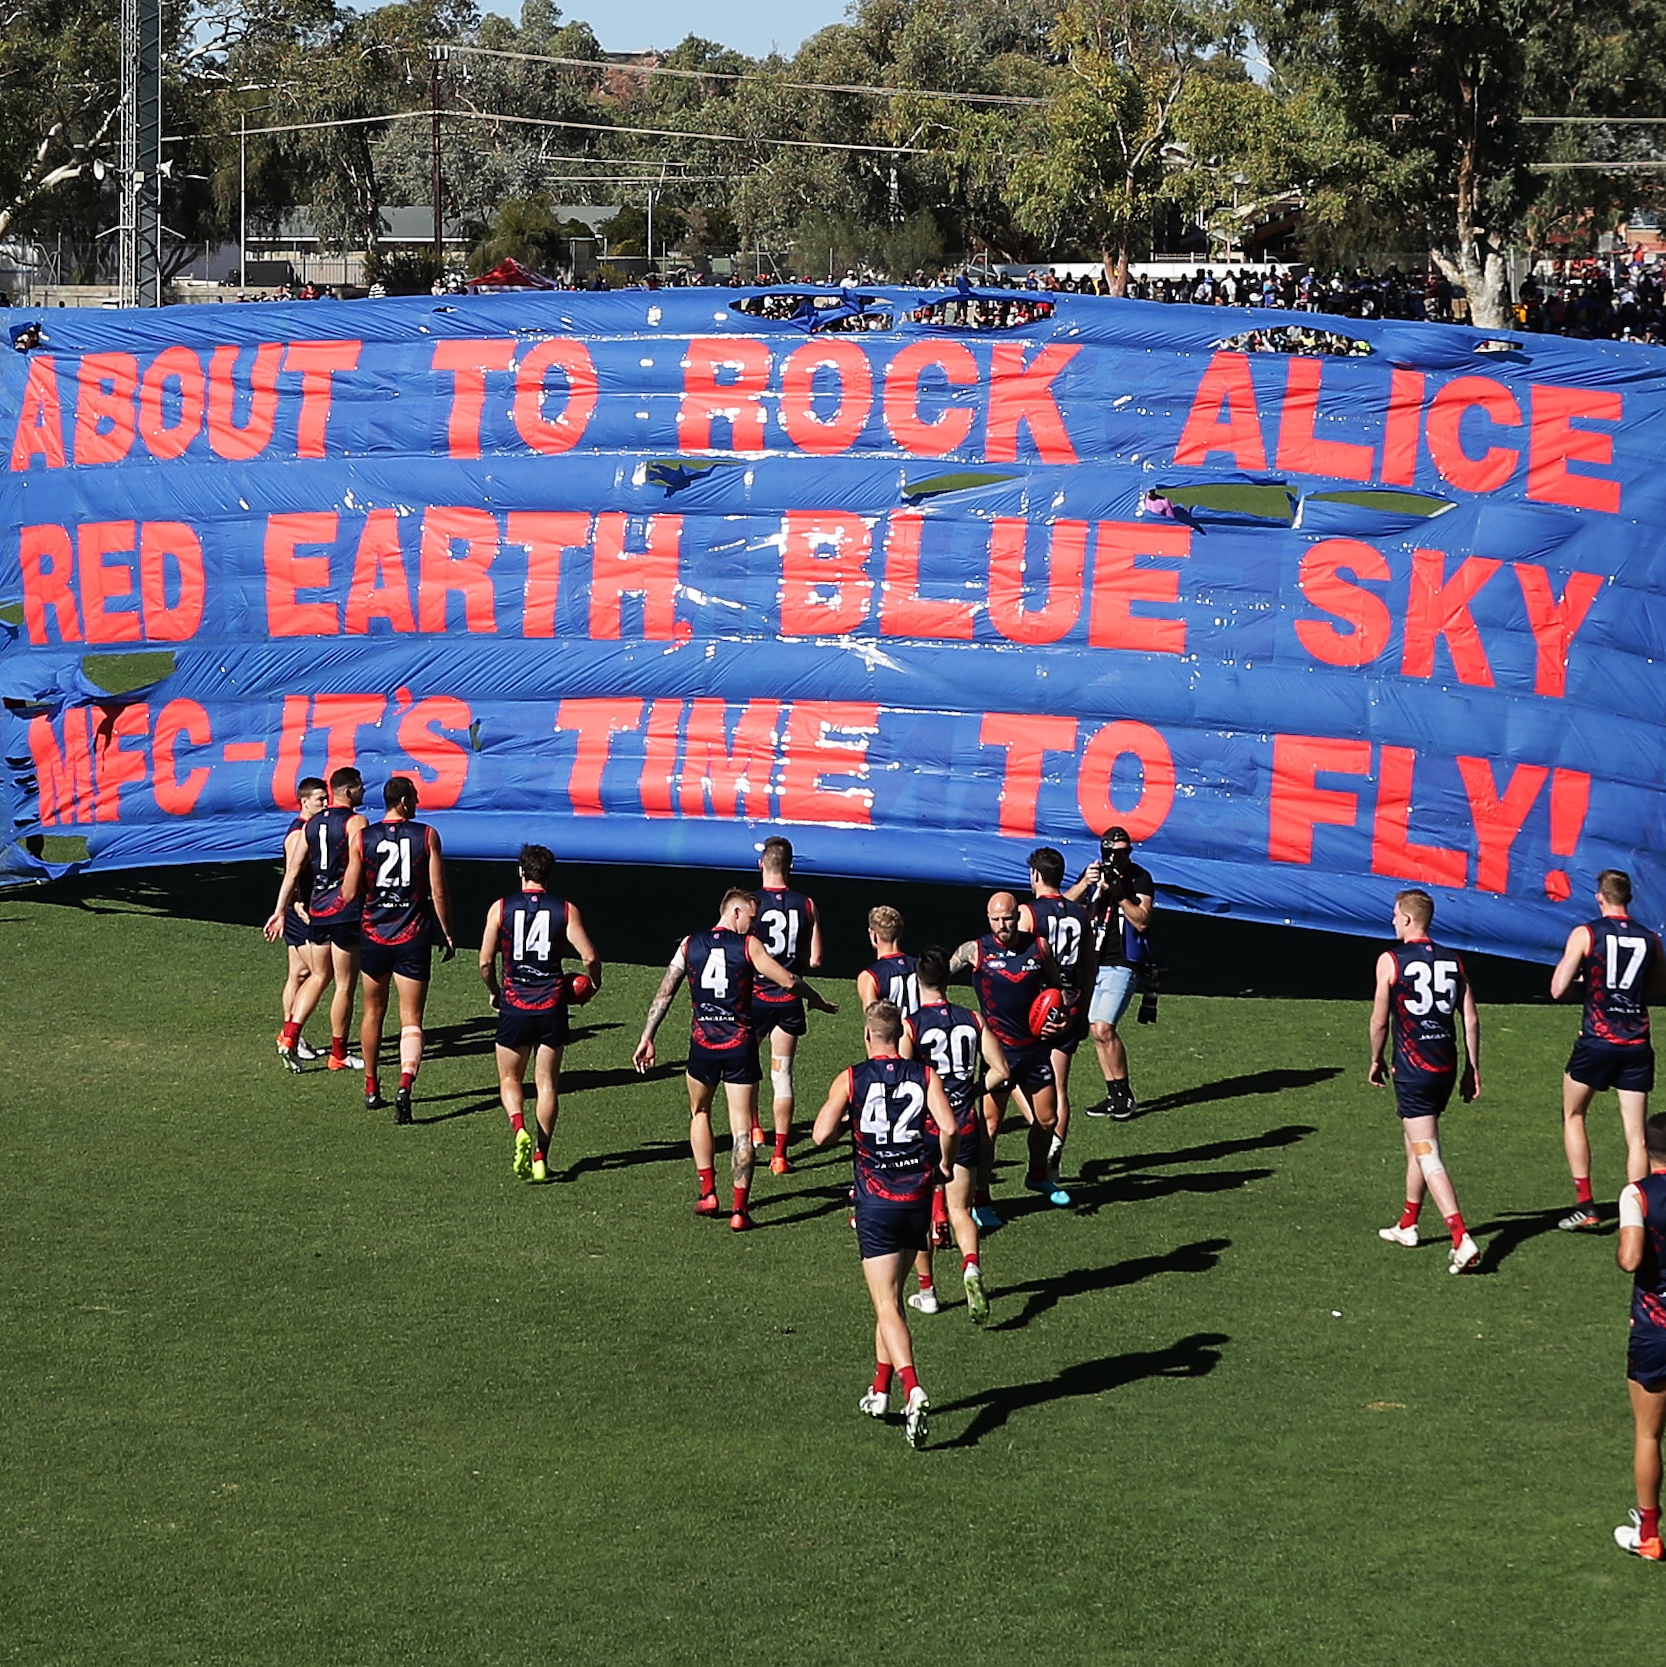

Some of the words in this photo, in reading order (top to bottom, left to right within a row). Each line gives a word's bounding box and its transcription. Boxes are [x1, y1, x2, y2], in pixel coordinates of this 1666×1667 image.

[10, 337, 362, 473] ABOUT
[432, 337, 599, 460] TO
[677, 336, 1081, 464] ROCK
[1173, 350, 1623, 514] ALICE
[19, 519, 205, 645] RED
[781, 508, 1192, 654] BLUE
[1294, 537, 1604, 698] SKY
[28, 685, 474, 826] MFC-IT'S
[555, 696, 880, 827] TIME
[979, 711, 1176, 842] TO
[1268, 734, 1592, 904] FLY!
[318, 823, 328, 871] 1
[375, 837, 411, 888] 21
[512, 908, 552, 961] 14
[760, 908, 800, 959] 31
[700, 947, 730, 999] 4
[1403, 960, 1459, 1016] 35
[1605, 934, 1647, 990] 17
[920, 1024, 979, 1082] 30
[859, 1080, 924, 1145] 42
